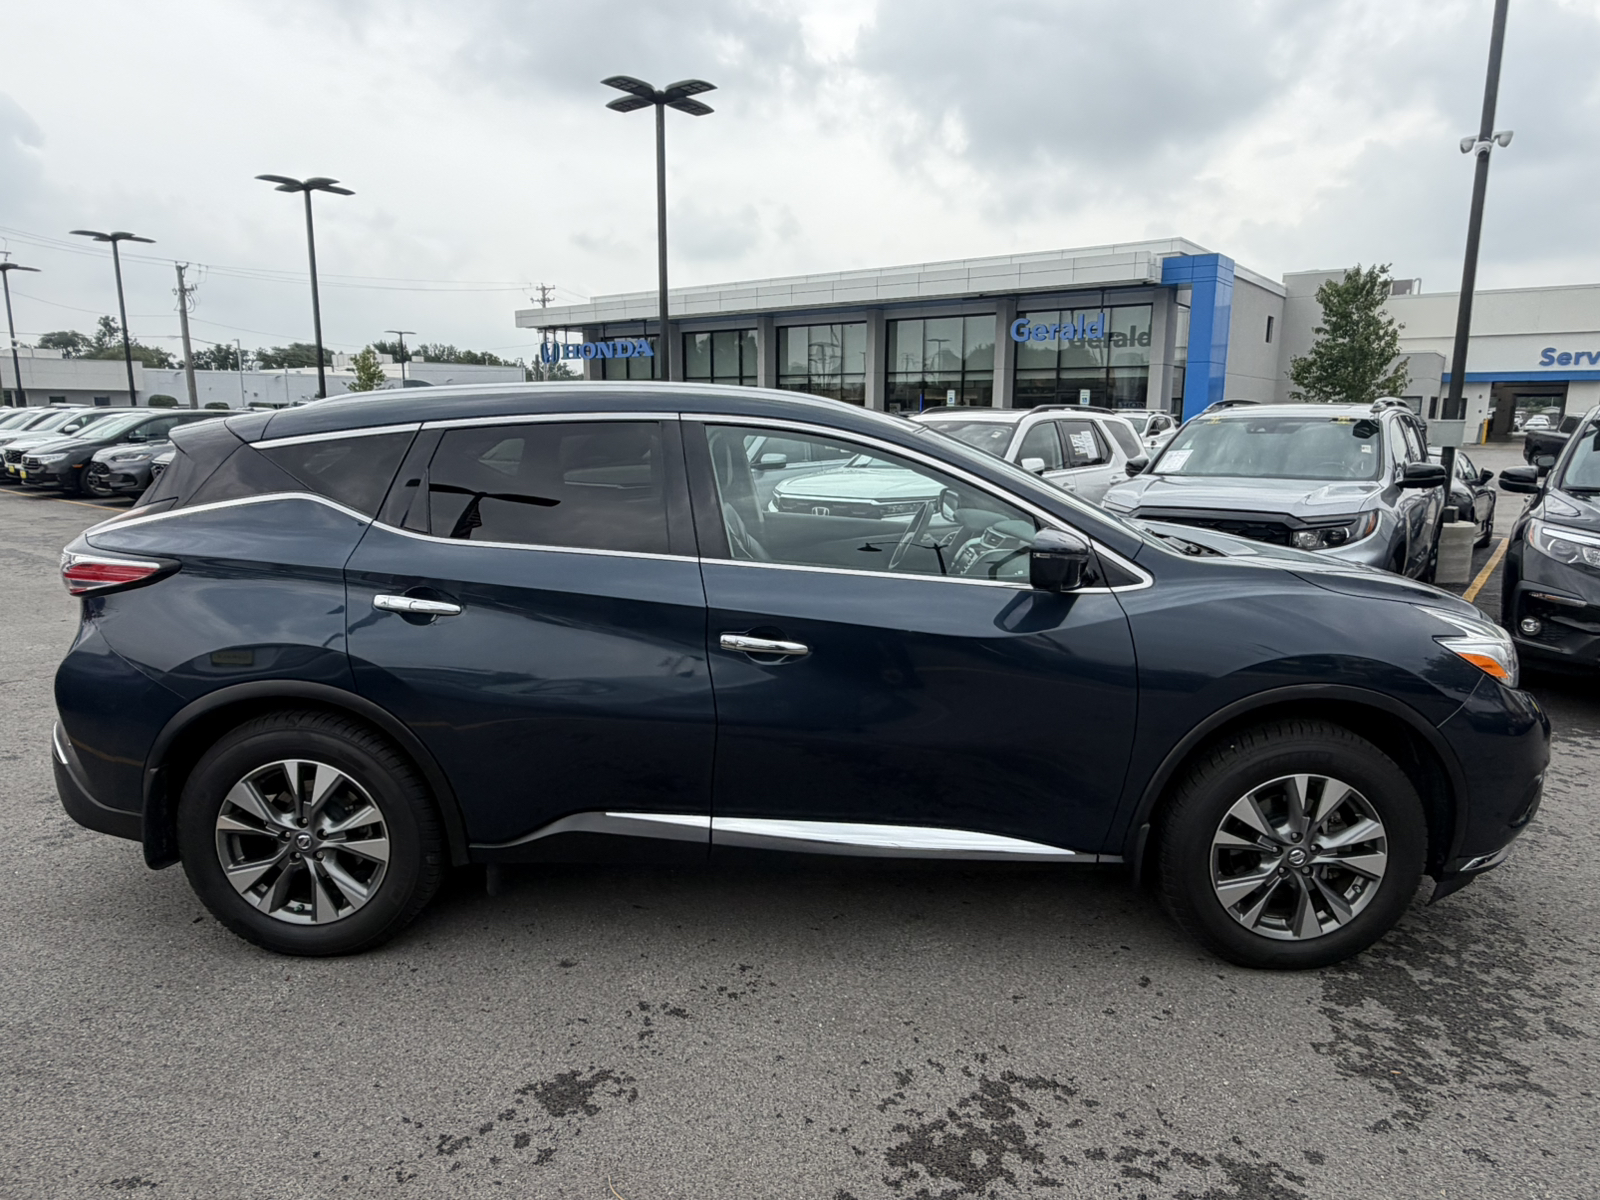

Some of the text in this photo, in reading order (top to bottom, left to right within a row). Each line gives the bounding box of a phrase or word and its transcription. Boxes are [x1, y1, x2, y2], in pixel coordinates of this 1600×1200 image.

[1010, 312, 1105, 342] Gerald
[561, 339, 654, 360] HONDA
[1539, 347, 1600, 366] Serv
